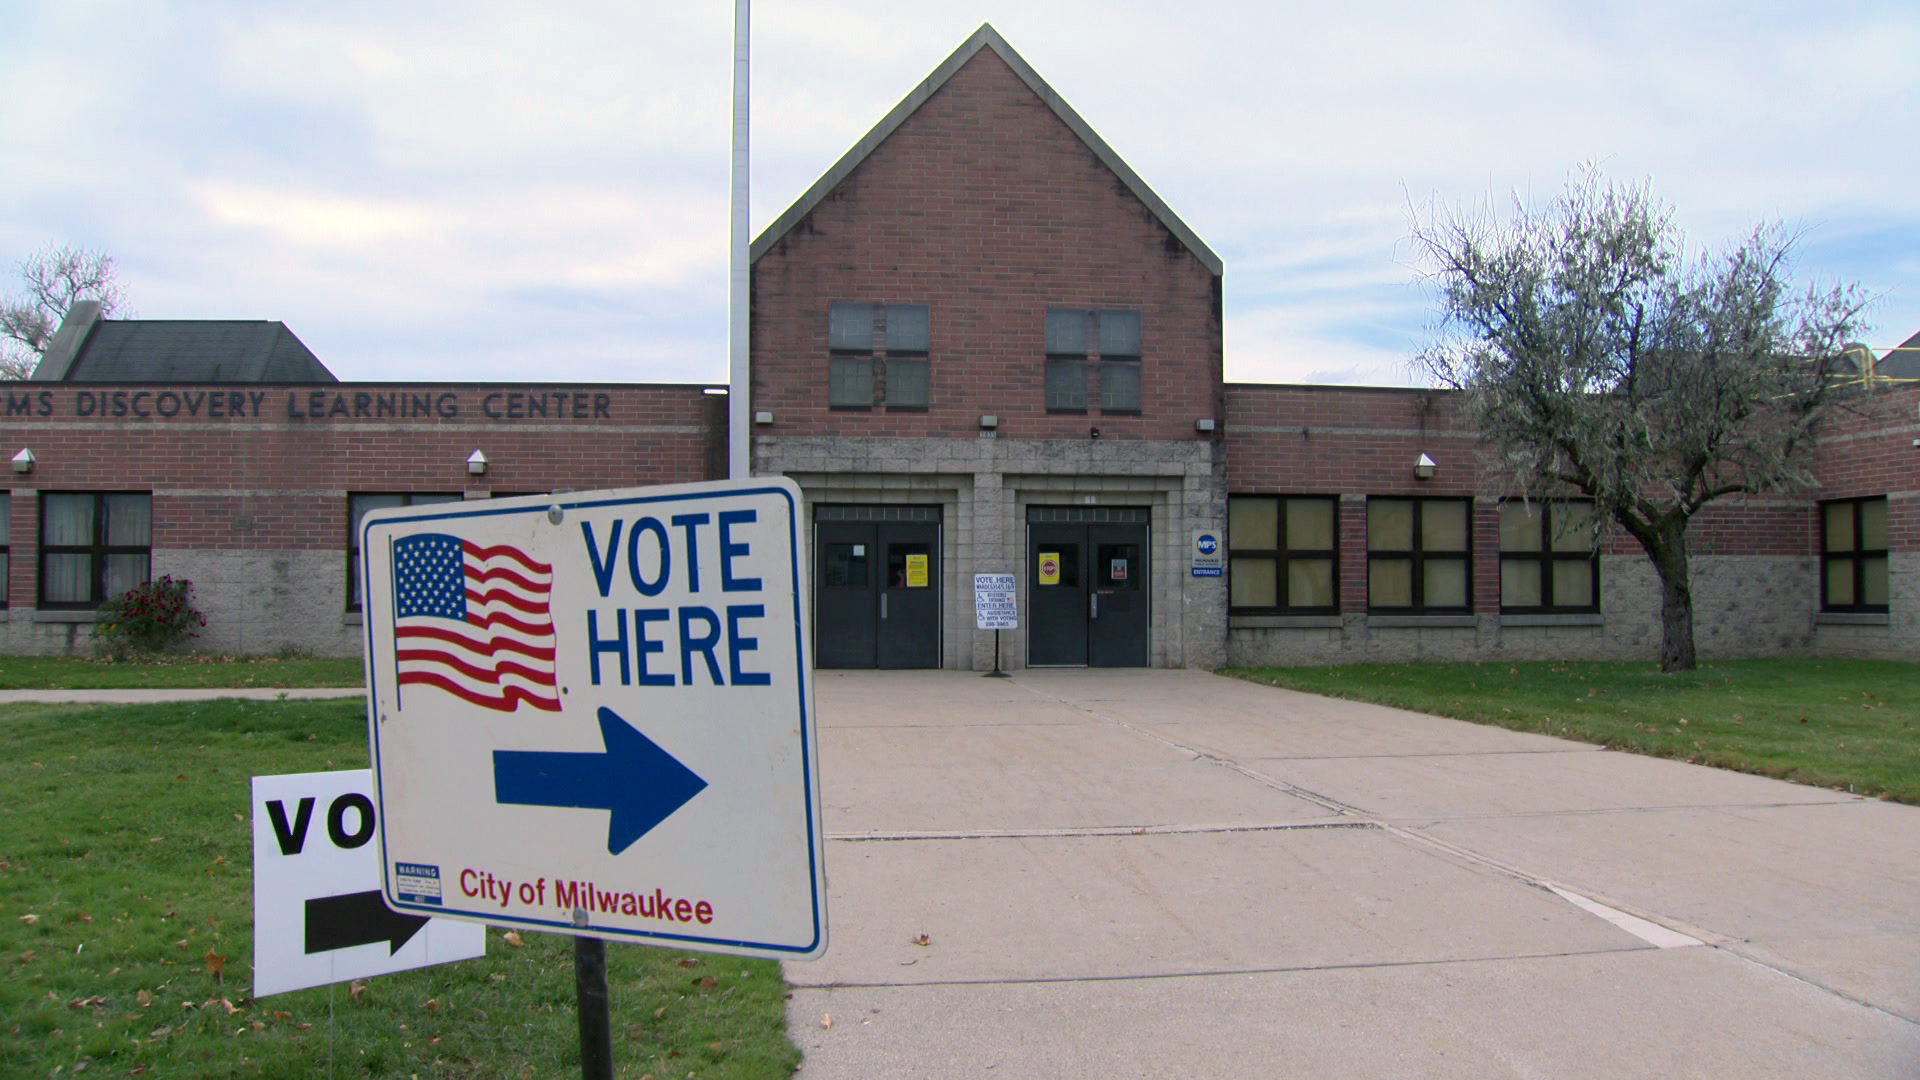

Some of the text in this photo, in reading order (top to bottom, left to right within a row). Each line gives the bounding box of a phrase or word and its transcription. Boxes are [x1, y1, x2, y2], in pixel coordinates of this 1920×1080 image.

[4, 391, 612, 419] MS DISCOVERY LEARNING CENTER
[580, 509, 763, 598] VOTE
[1197, 540, 1217, 549] MPS
[587, 604, 771, 686] HERE
[265, 792, 376, 856] VO
[399, 866, 436, 877] WARNING
[459, 868, 512, 908] City
[518, 877, 545, 906] of
[554, 879, 714, 925] Milwaukee
